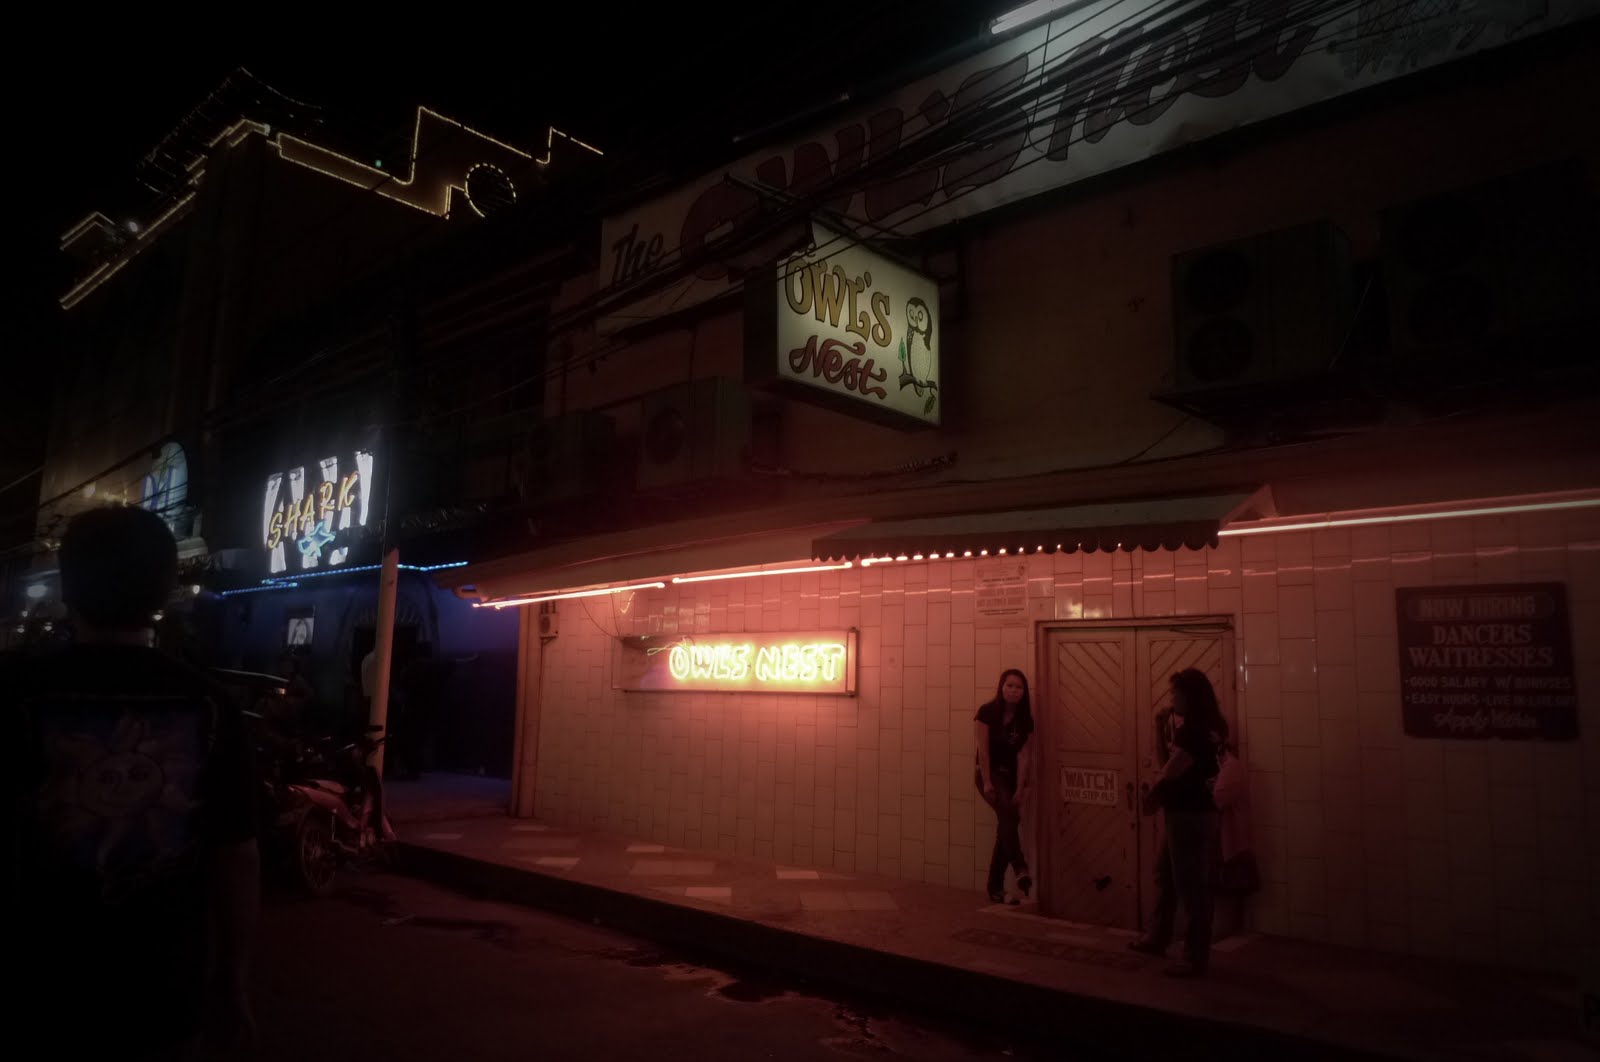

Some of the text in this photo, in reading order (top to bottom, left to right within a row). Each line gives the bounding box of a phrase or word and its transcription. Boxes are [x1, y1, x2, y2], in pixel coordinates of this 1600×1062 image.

[785, 256, 892, 347] OWL'S
[789, 335, 887, 399] Nest
[267, 471, 358, 549] SHARK
[1419, 595, 1536, 617] NOW HIRING
[1432, 624, 1533, 645] DANCERS
[669, 643, 846, 682] OWLS NEST
[1408, 646, 1553, 668] WAITRESSES
[1064, 771, 1114, 791] WATCH
